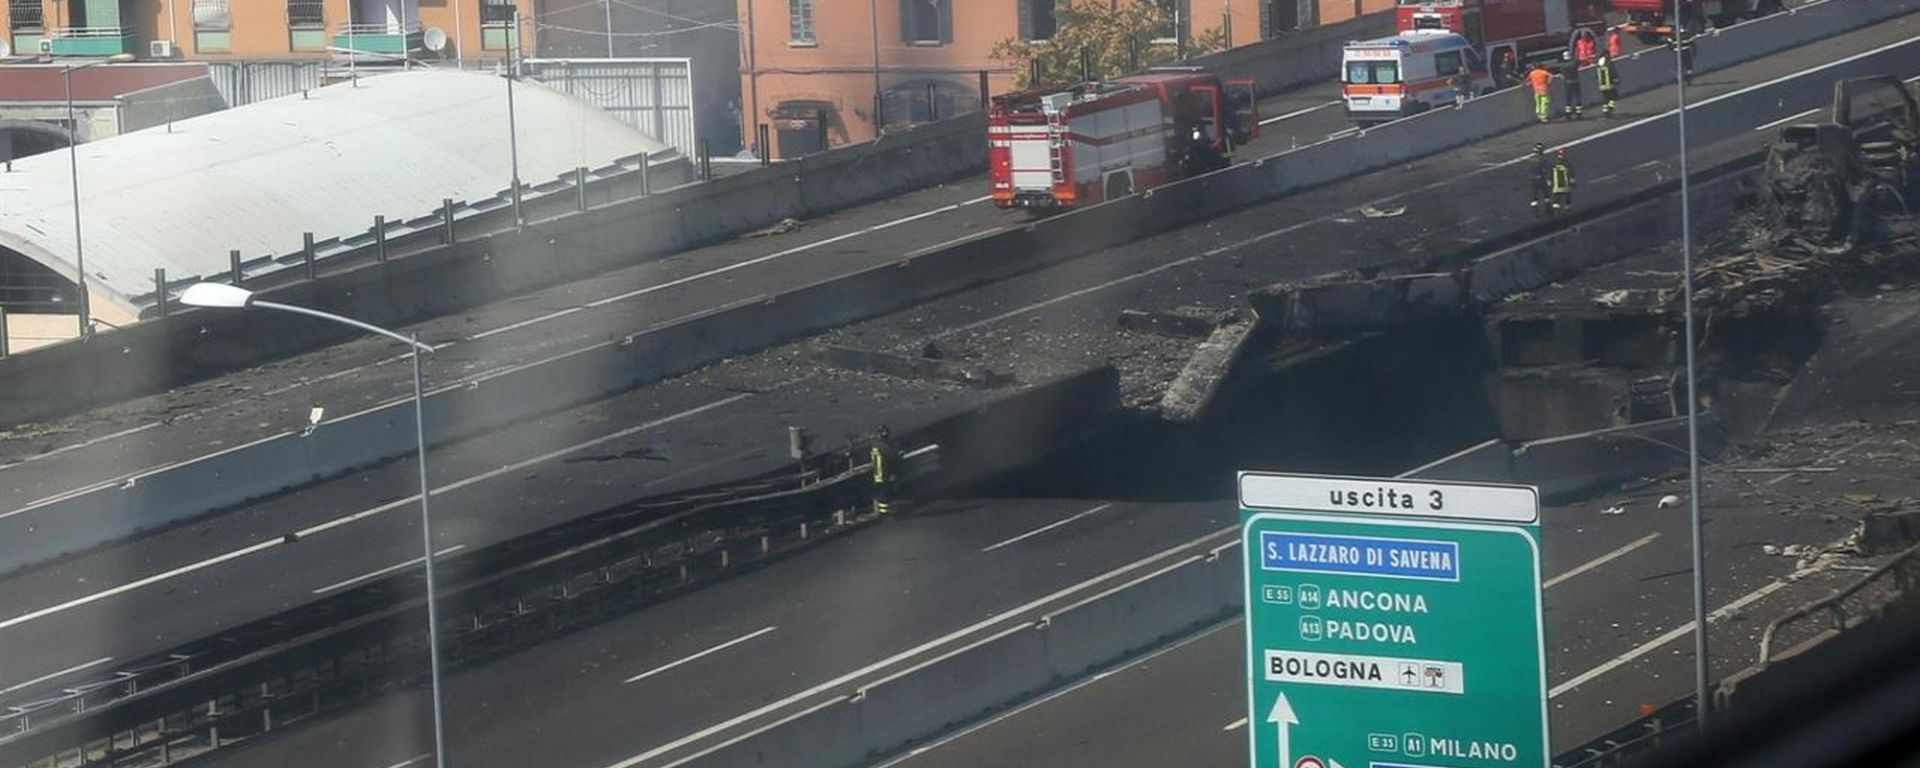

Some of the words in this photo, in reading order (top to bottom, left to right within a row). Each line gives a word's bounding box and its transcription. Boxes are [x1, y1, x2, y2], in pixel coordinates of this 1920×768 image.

[1330, 488, 1414, 509] uscita
[1429, 489, 1444, 510] 3
[1268, 542, 1282, 560] S.
[1289, 543, 1359, 564] LAZZARO
[1367, 547, 1383, 566] DI
[1390, 548, 1452, 571] SAVENA
[1301, 590, 1318, 602] A14
[1326, 589, 1428, 613] ANCONA
[1302, 621, 1320, 635] A13
[1326, 620, 1416, 644] PADOVA
[1271, 656, 1382, 681] BOLOGNA
[1408, 738, 1420, 752] A1
[1430, 737, 1517, 761] MILANO
